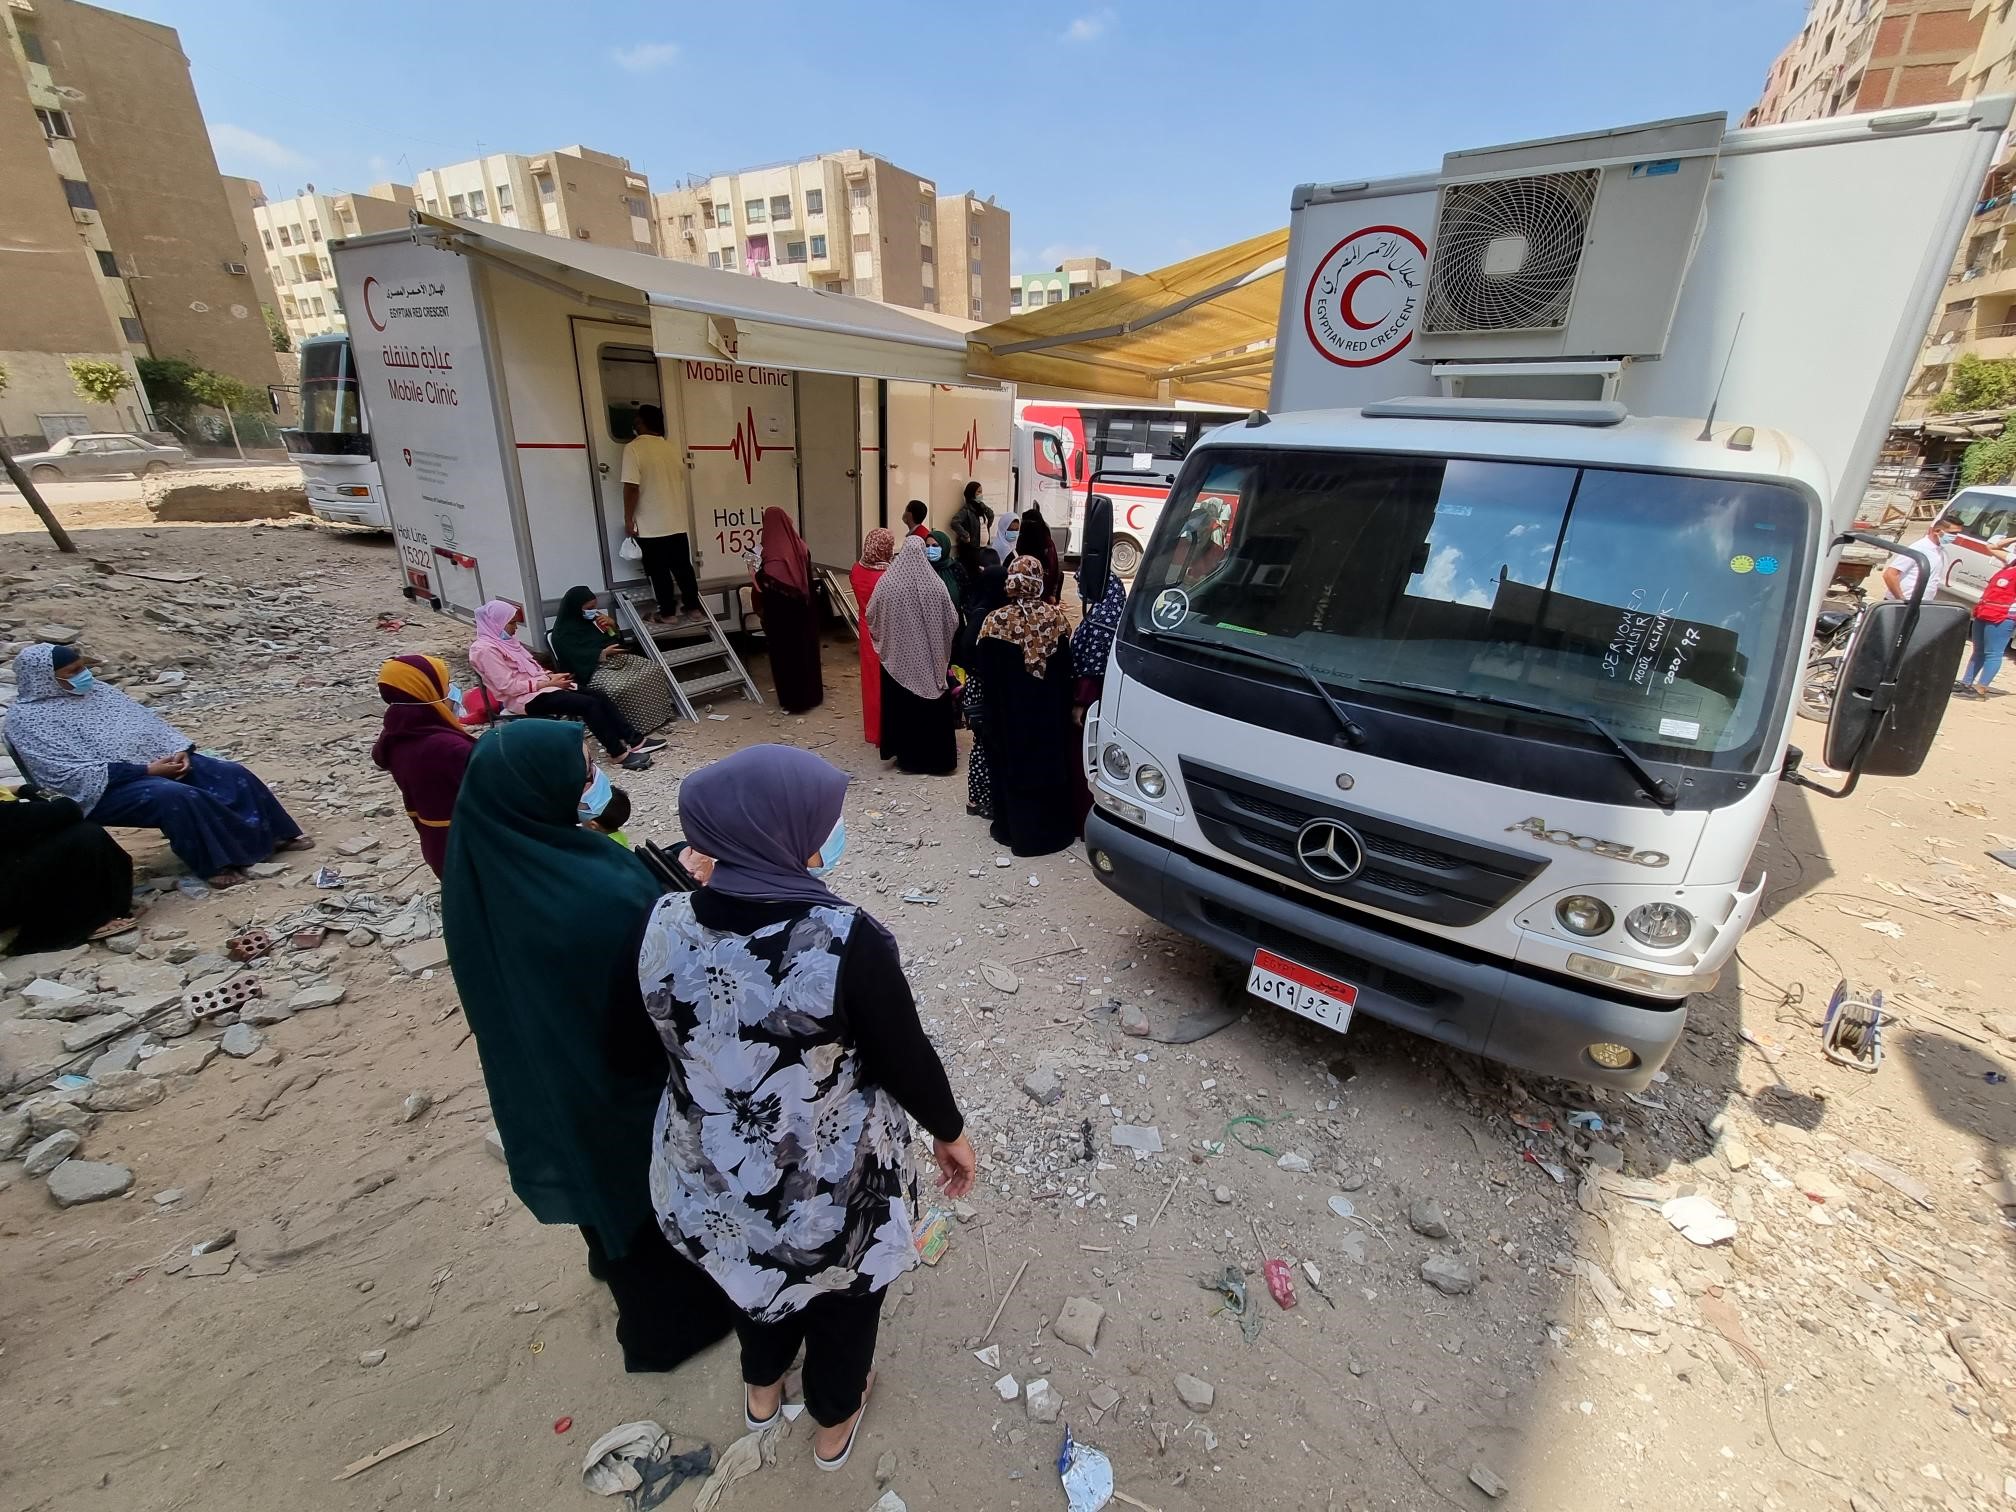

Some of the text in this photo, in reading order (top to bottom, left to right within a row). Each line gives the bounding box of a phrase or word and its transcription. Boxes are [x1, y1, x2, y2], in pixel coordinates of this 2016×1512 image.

[389, 305, 450, 319] EGYPTIAN RED CRESCENT
[1317, 296, 1417, 352] EGYPTIAN RED CRESCENT
[382, 344, 453, 375] عيادة متنقلة
[686, 360, 789, 387] Mobile Clinic
[388, 378, 458, 406] Mobile Clinic
[714, 506, 765, 528] Hot Li
[397, 522, 412, 541] Hot
[411, 527, 428, 545] Line
[715, 527, 763, 555] 153
[402, 544, 433, 570] 15322
[1159, 601, 1182, 620] 72
[1263, 956, 1296, 977] EGYPT
